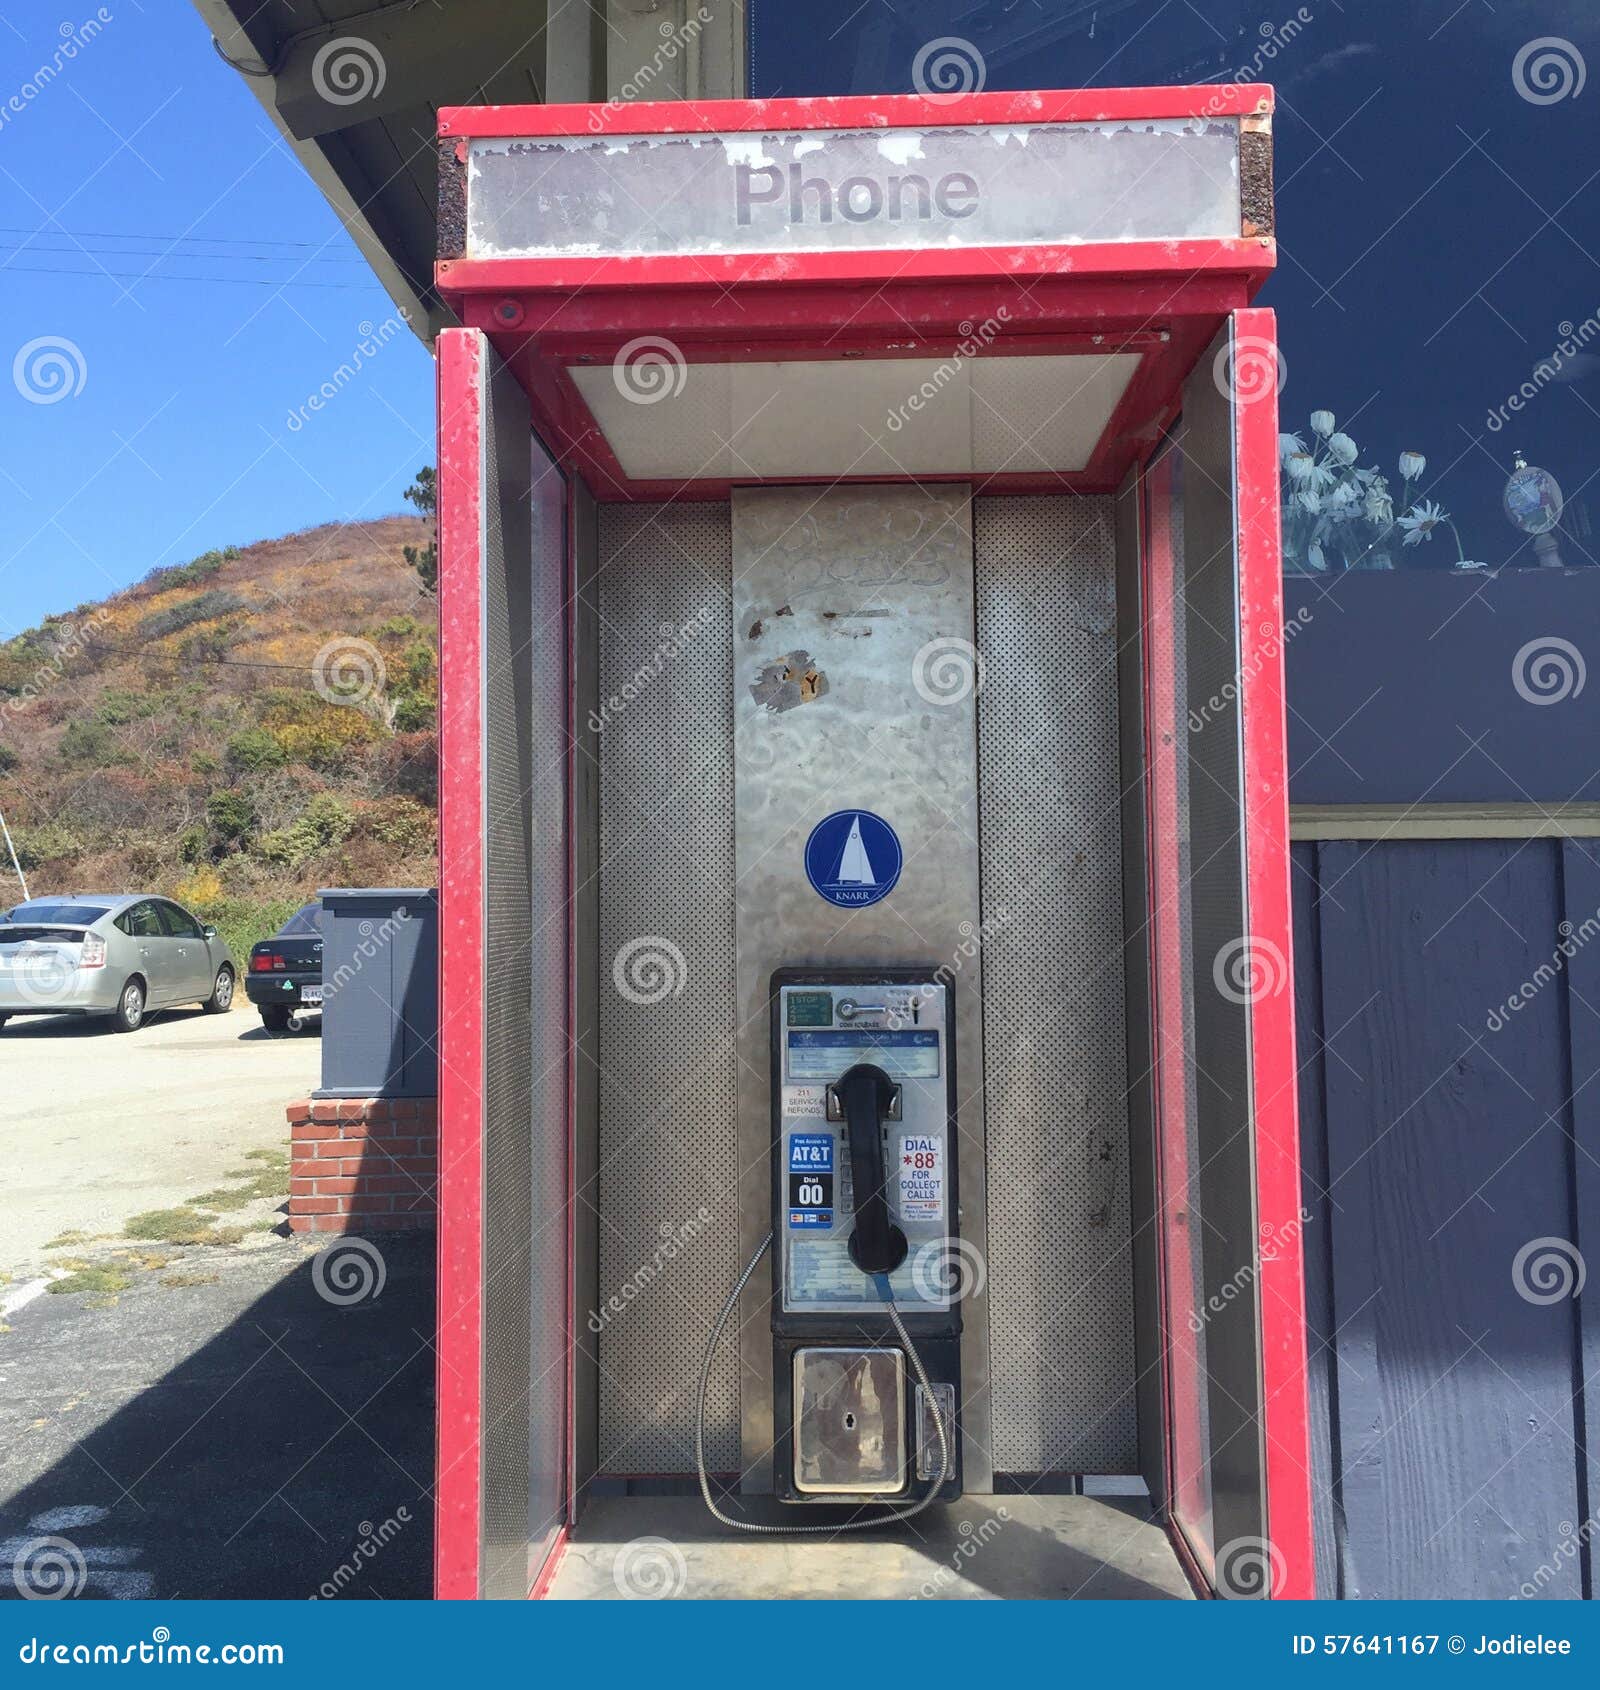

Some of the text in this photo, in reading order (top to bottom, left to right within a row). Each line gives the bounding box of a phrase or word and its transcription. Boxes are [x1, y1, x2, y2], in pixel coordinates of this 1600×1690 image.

[735, 162, 980, 226] Phone
[835, 891, 870, 900] KNARR
[905, 1140, 936, 1151] DIAL
[792, 1146, 830, 1161] AT&T
[912, 1170, 930, 1179] FOR
[900, 1180, 941, 1190] COLLECT
[798, 1184, 823, 1205] 00
[906, 1190, 935, 1200] CALLS
